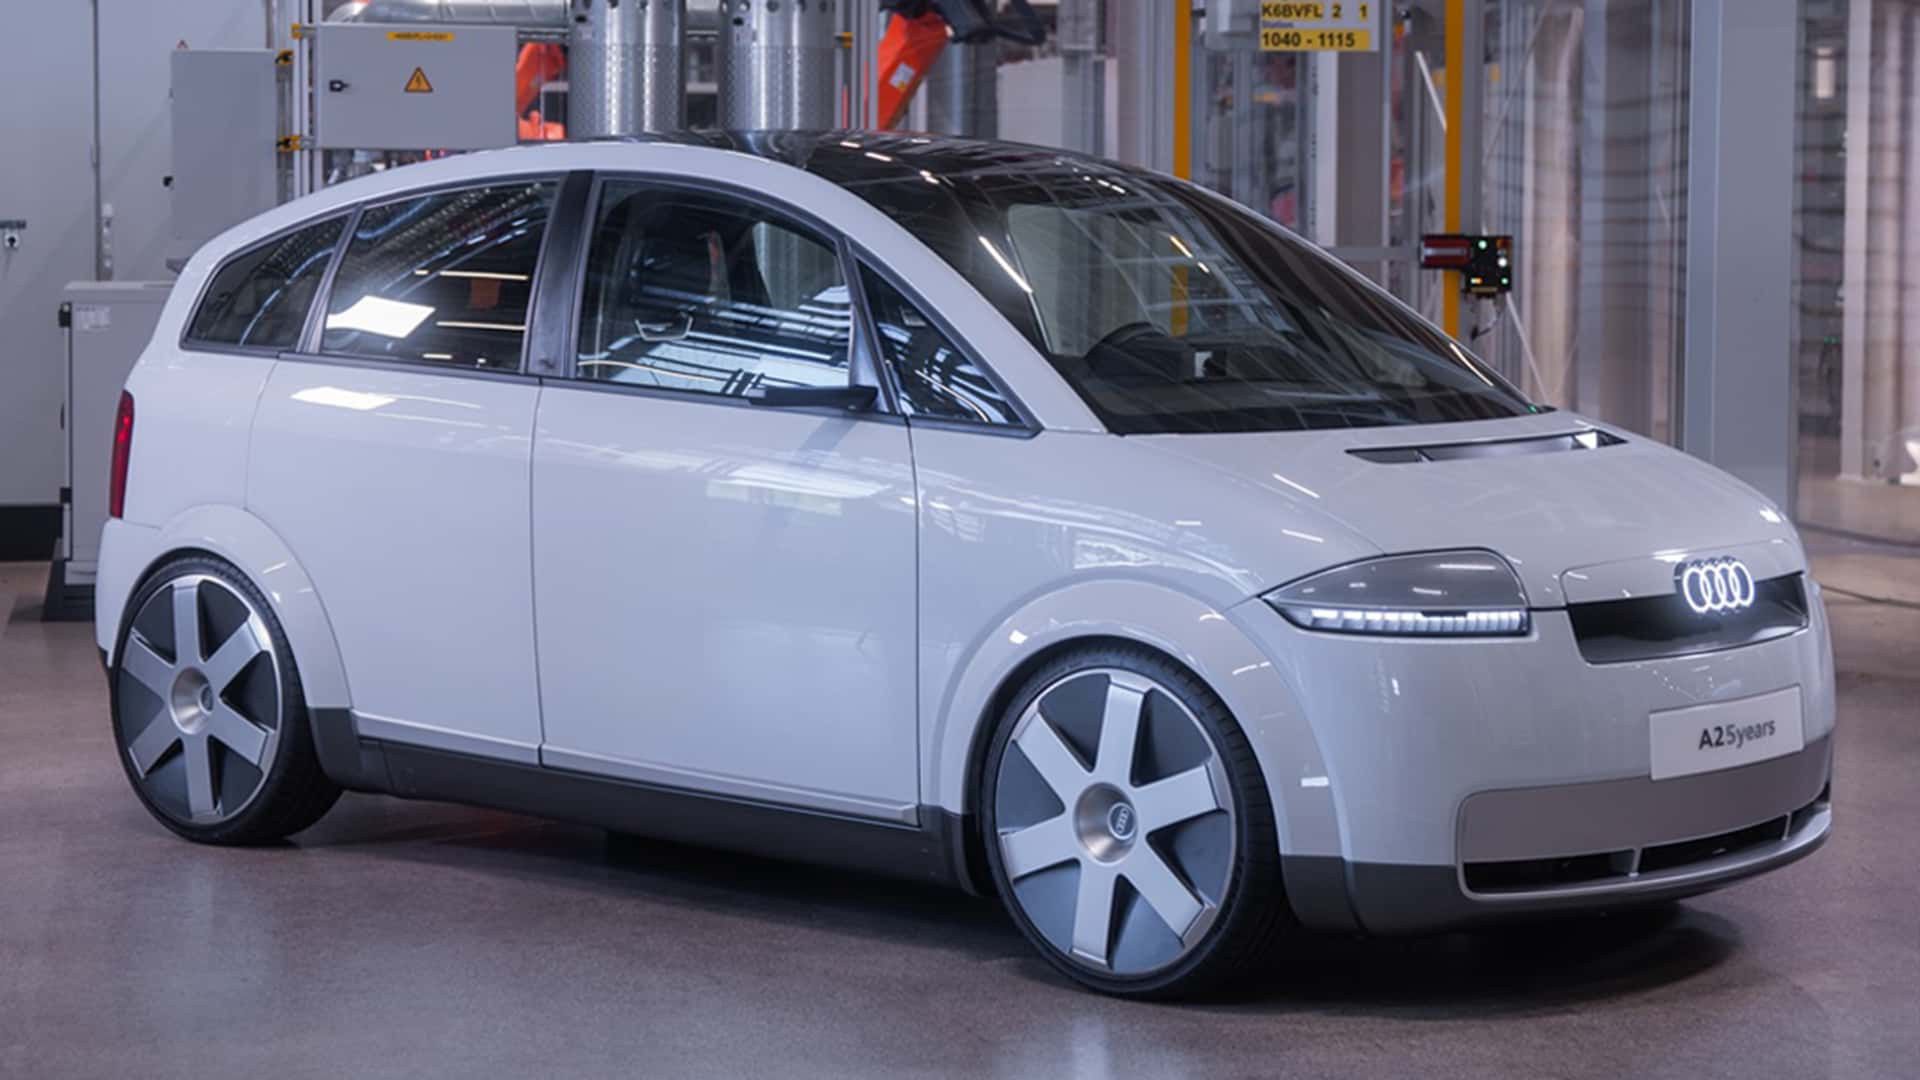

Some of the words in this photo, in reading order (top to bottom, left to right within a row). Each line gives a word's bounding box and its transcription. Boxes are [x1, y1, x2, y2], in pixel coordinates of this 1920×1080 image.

[1332, 4, 1341, 18] 2
[1359, 4, 1367, 18] 1
[1263, 32, 1301, 47] 1040
[1318, 32, 1355, 47] 1115
